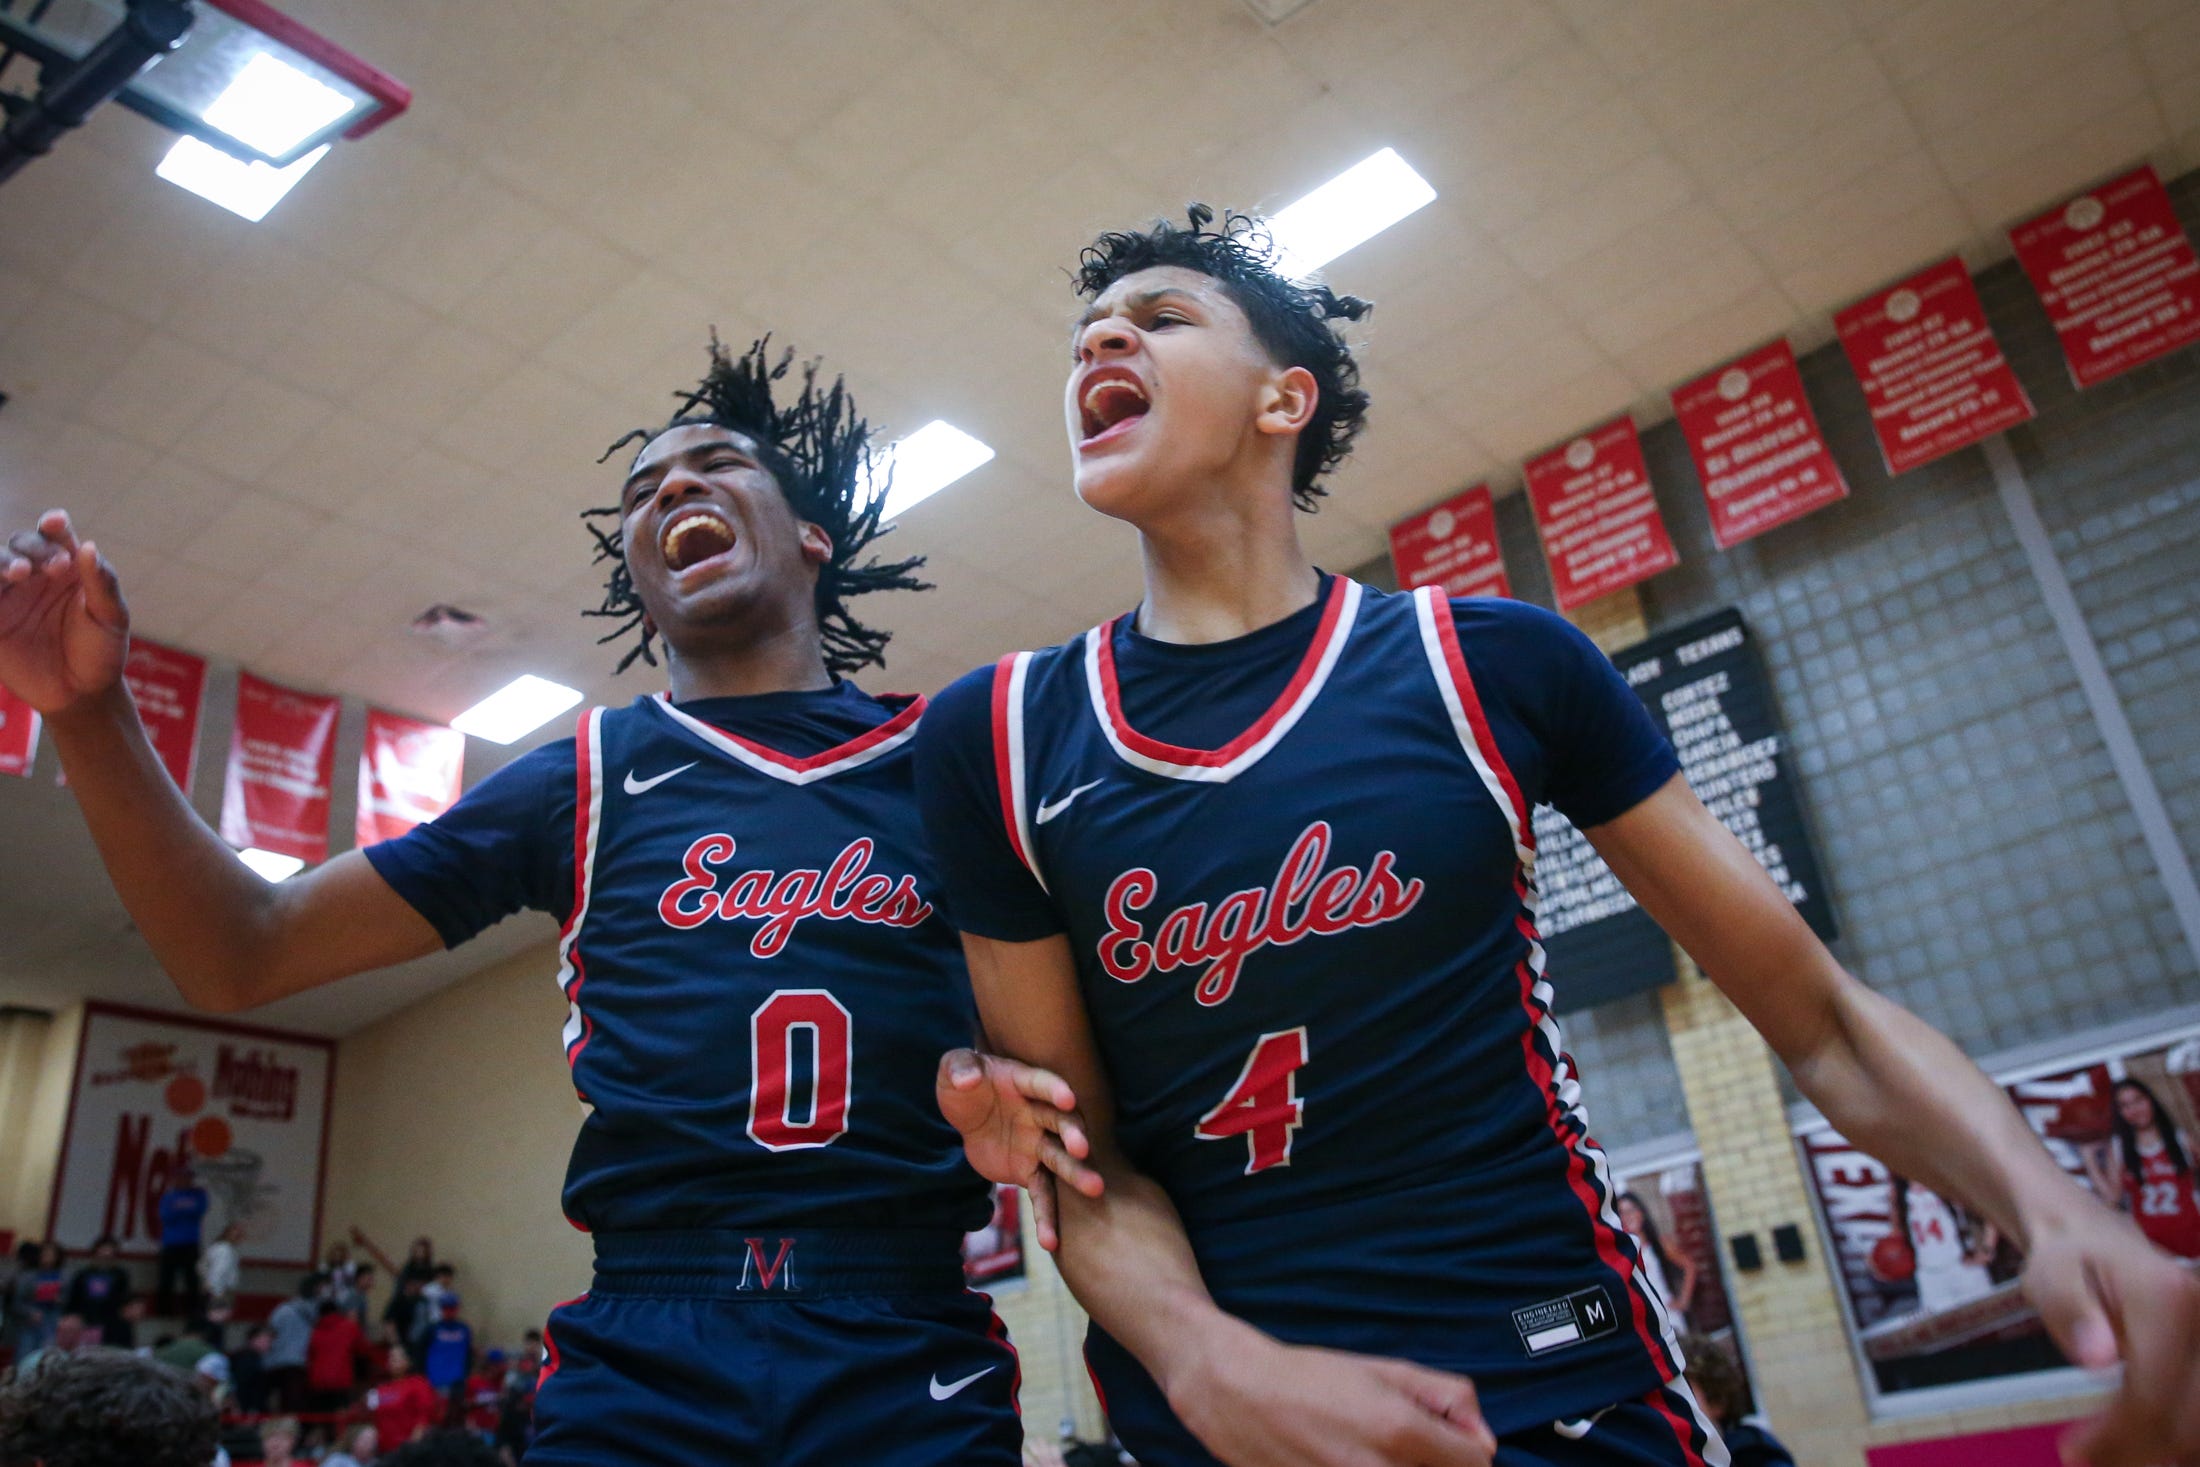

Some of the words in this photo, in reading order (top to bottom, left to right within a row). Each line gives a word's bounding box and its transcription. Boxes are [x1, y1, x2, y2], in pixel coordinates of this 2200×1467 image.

[1676, 626, 1744, 665] TEXANS
[658, 833, 932, 958] Eagles
[1097, 821, 1424, 1006] Eagles
[746, 989, 852, 1152] 0
[1194, 1026, 1308, 1175] 4
[2141, 1181, 2181, 1216] 22
[1585, 1300, 1605, 1325] M
